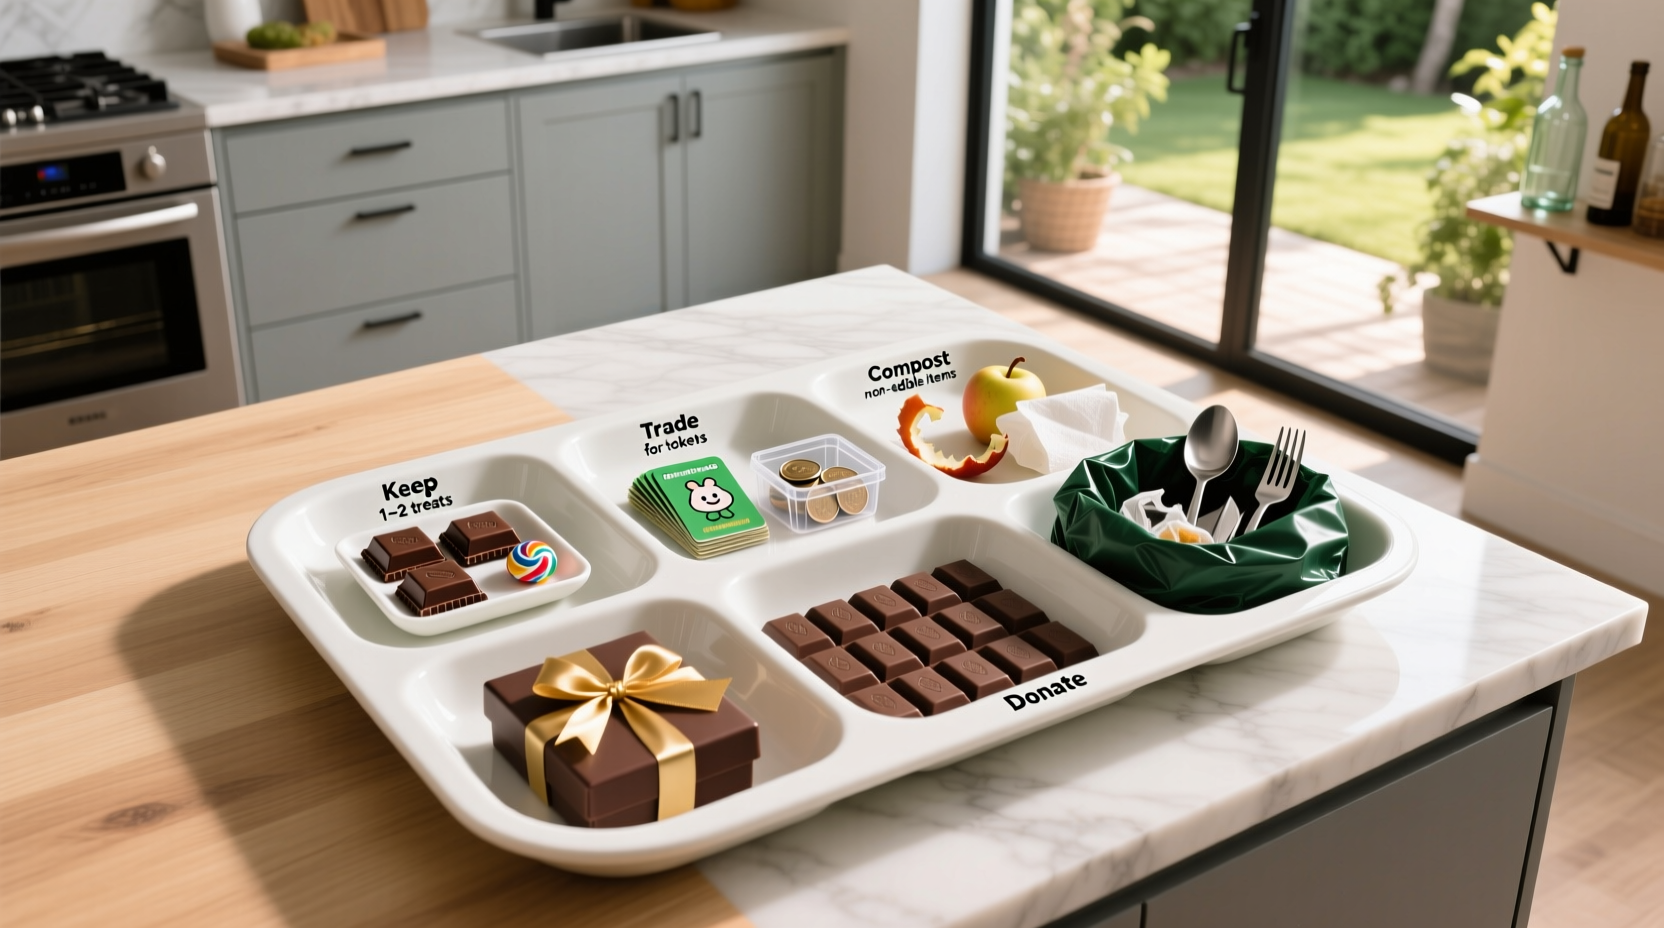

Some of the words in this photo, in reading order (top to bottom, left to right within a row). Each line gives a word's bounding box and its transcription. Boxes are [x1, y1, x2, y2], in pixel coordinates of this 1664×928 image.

[868, 350, 951, 382] Compost
[640, 413, 699, 440] Trade
[644, 442, 664, 457] for
[381, 476, 438, 502] Keep
[410, 495, 453, 515] treats
[1003, 674, 1088, 712] Donate
